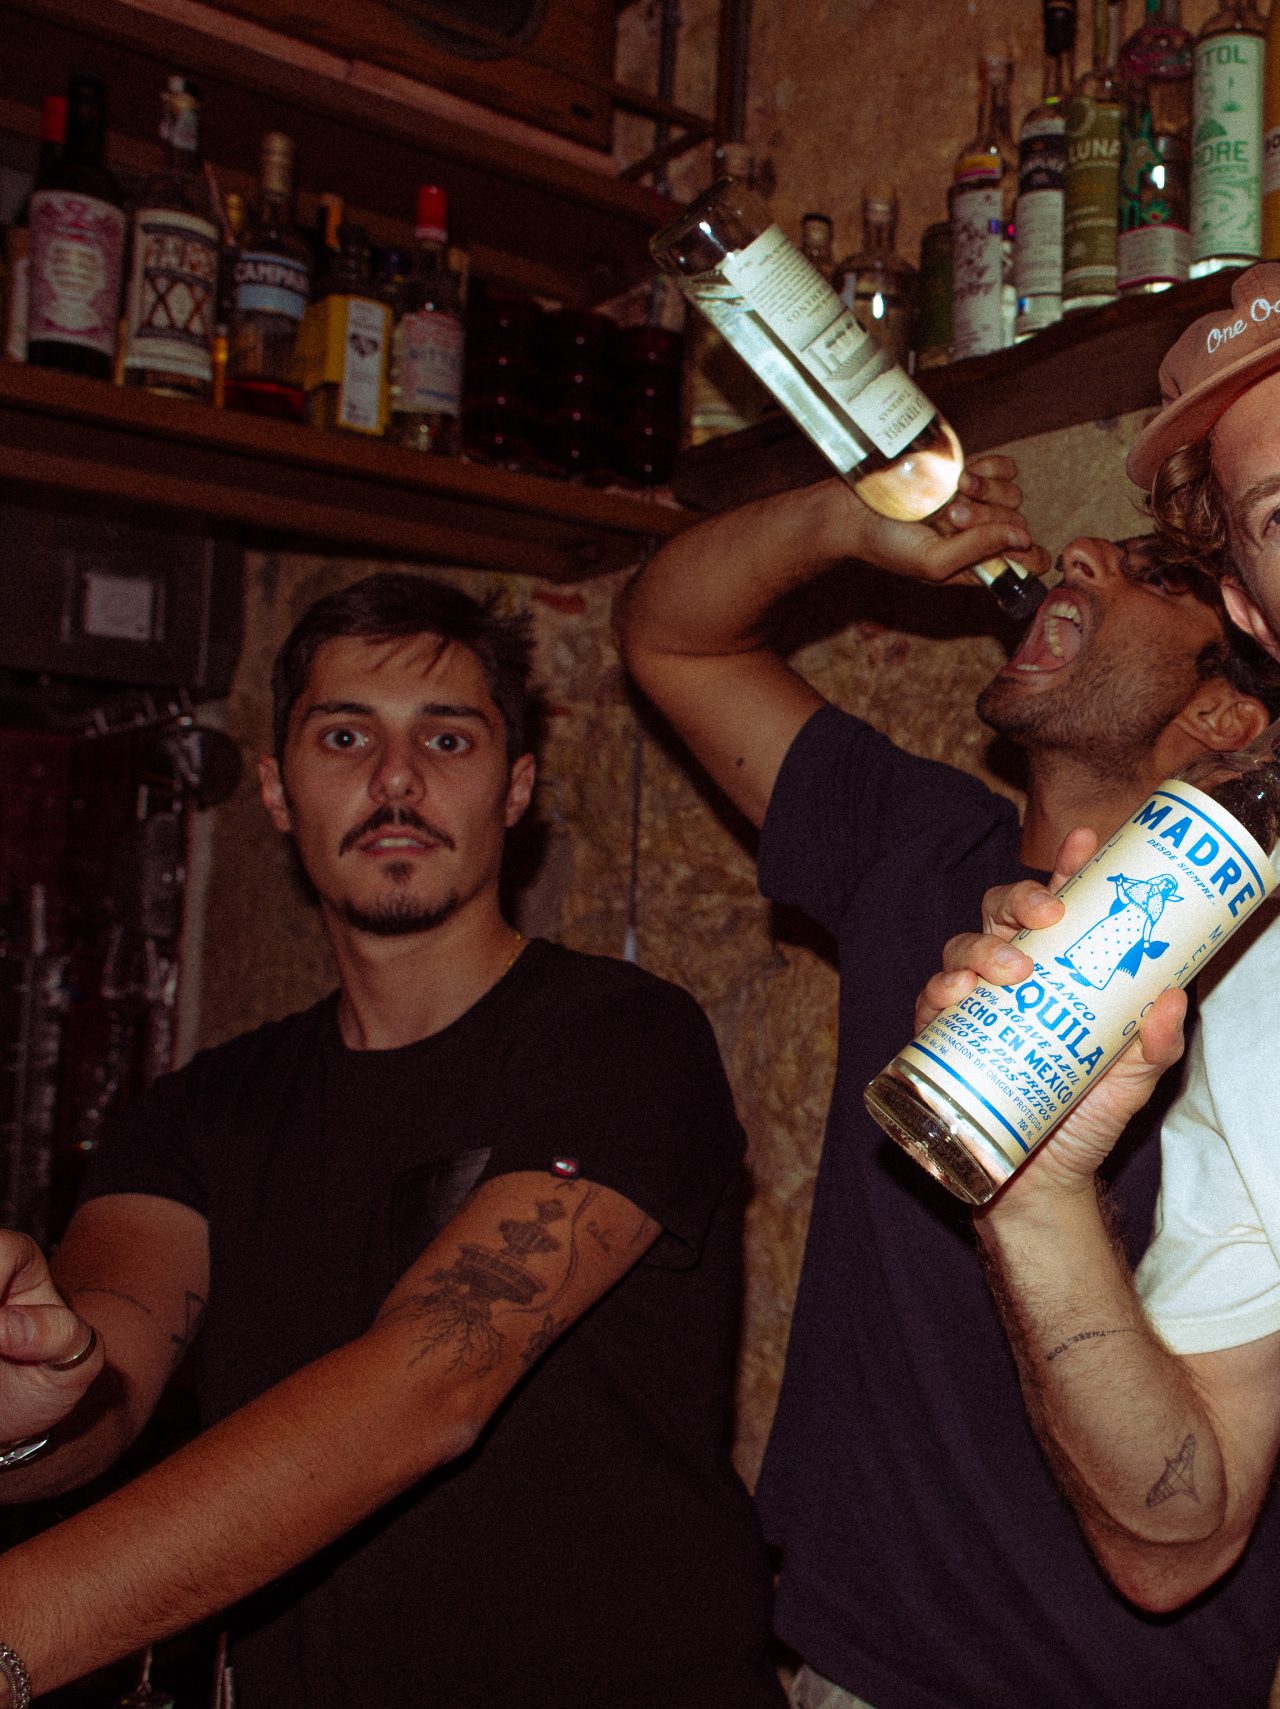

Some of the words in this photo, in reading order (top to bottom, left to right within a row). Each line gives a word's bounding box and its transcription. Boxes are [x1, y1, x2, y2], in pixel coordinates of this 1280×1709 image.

[1206, 319, 1248, 354] One
[1132, 800, 1256, 919] MADRE
[1146, 838, 1177, 862] DESDE
[1177, 862, 1215, 901] SIEMPRE
[1000, 978, 1105, 1077] QUILA
[1033, 962, 1096, 1022] BLANCO
[948, 1012, 992, 1042] AGAVE
[993, 1047, 1016, 1065] DE
[1017, 1071, 1057, 1112] PREDIO
[967, 1039, 991, 1055] DE
[990, 1059, 1019, 1082] LOS
[1017, 1086, 1052, 1121] ALTOS
[998, 1025, 1026, 1052] EN
[1023, 1048, 1073, 1105] MEXICO
[999, 1006, 1051, 1049] AGAVE
[1048, 1053, 1081, 1086] AZUL
[973, 1058, 987, 1071] DE
[986, 1069, 1014, 1098] ORIGEN
[1013, 1096, 1043, 1133] PROTEGIDA
